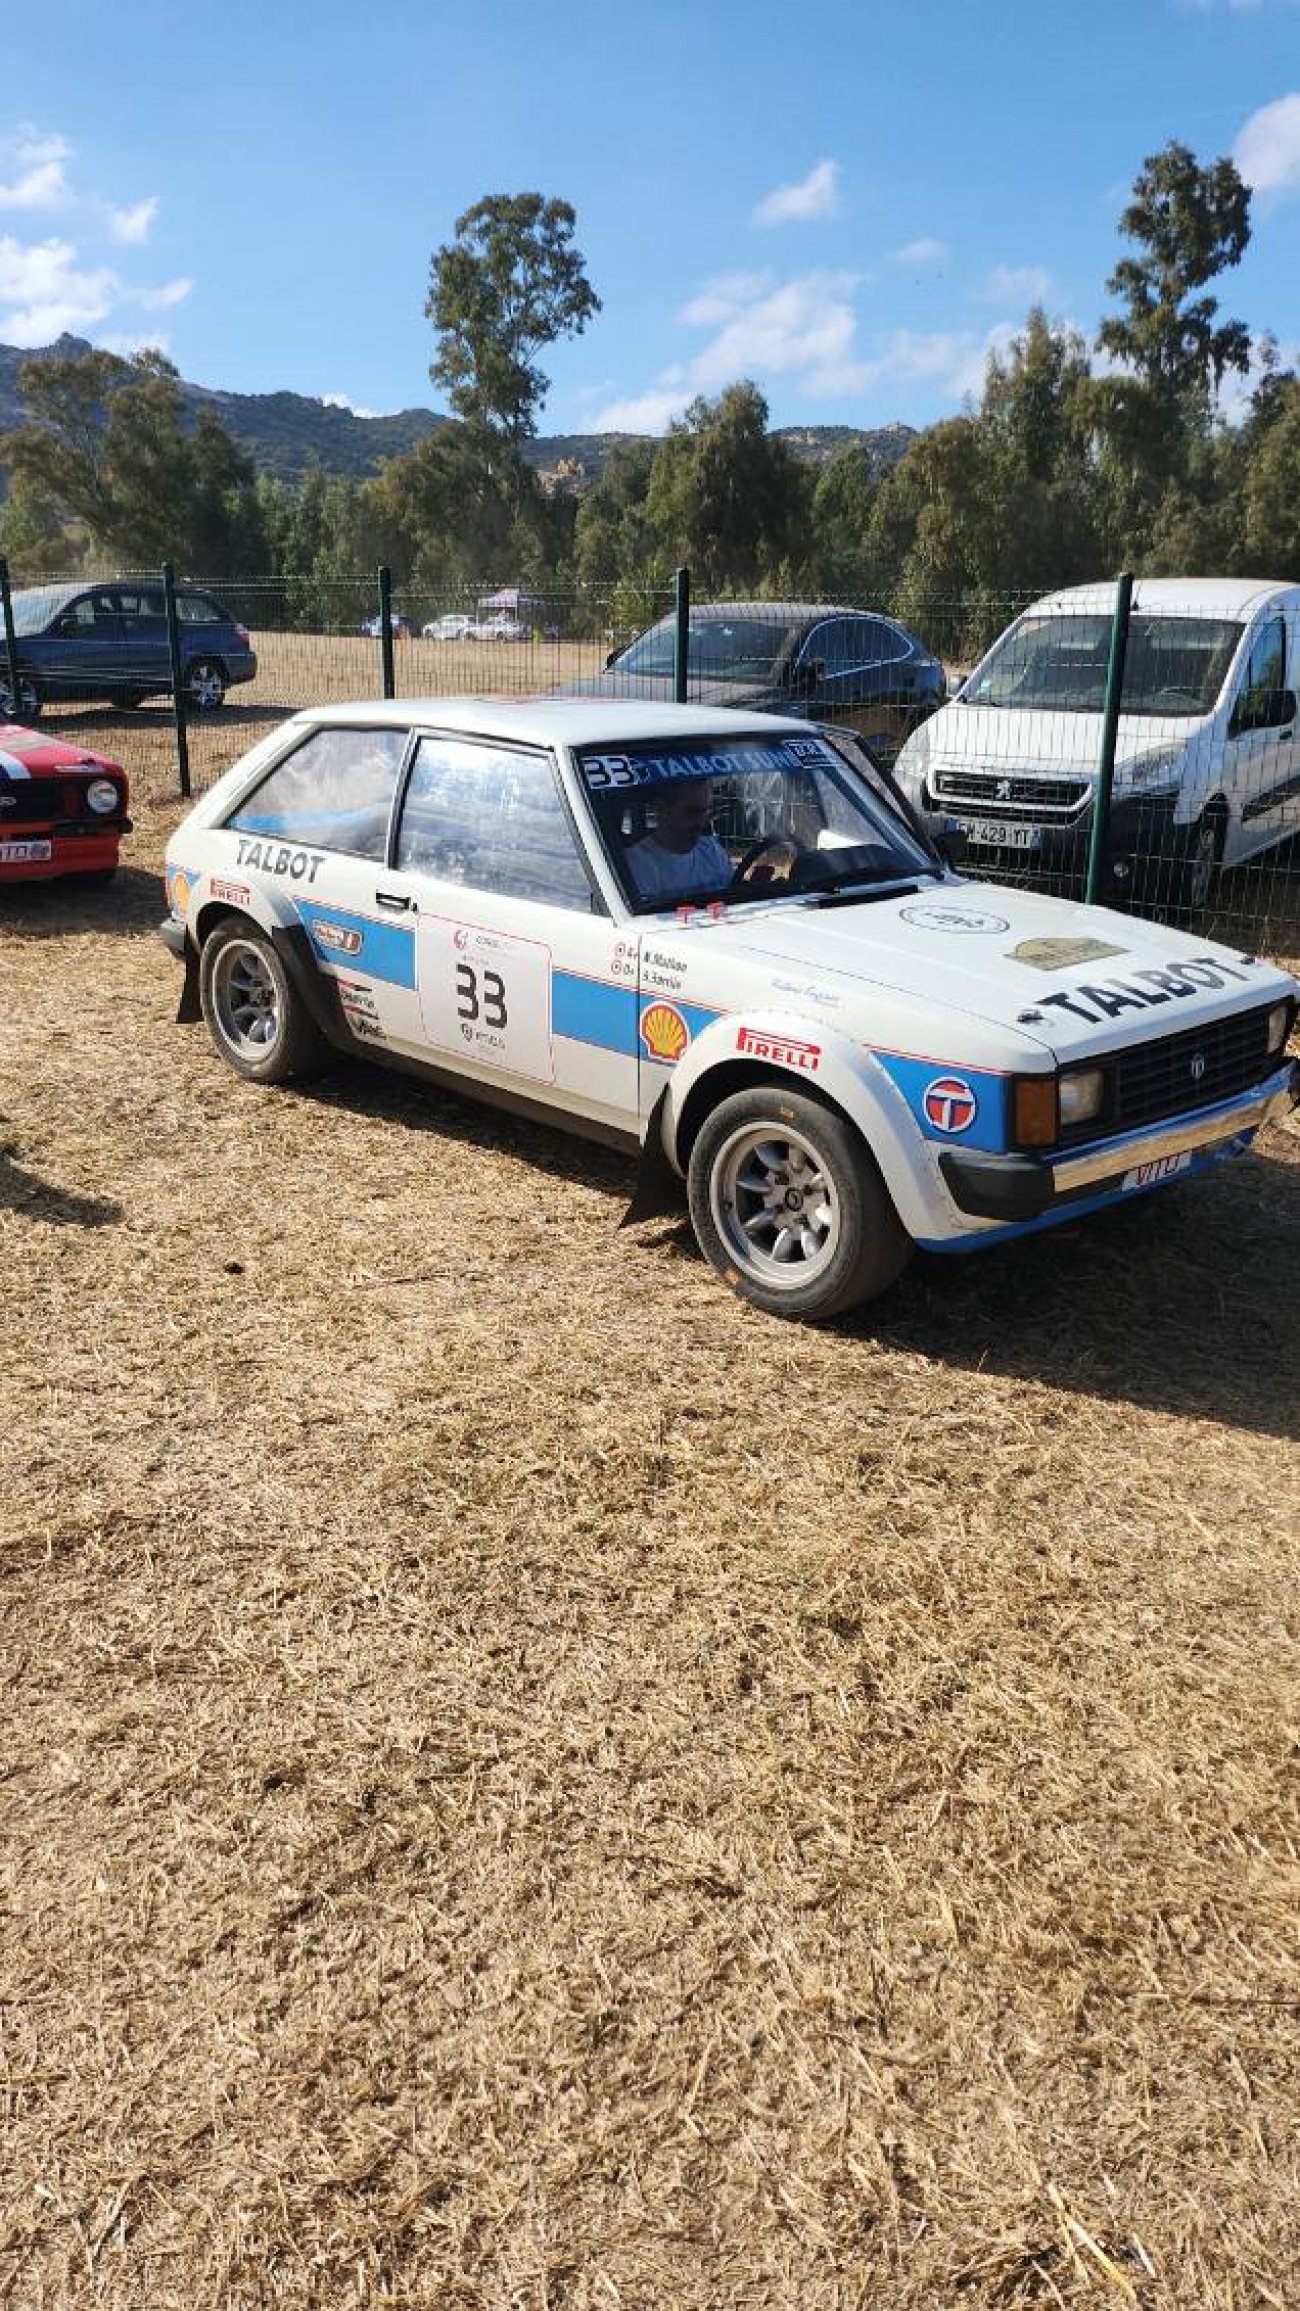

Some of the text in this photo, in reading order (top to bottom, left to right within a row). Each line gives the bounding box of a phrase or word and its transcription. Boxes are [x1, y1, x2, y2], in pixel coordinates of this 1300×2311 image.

[584, 757, 634, 787] 33
[650, 752, 746, 778] TALBOT
[236, 839, 326, 883] TALBOT
[456, 963, 508, 1029] 33
[1035, 957, 1251, 1024] TALBOT
[736, 1027, 821, 1071] PIRELLI
